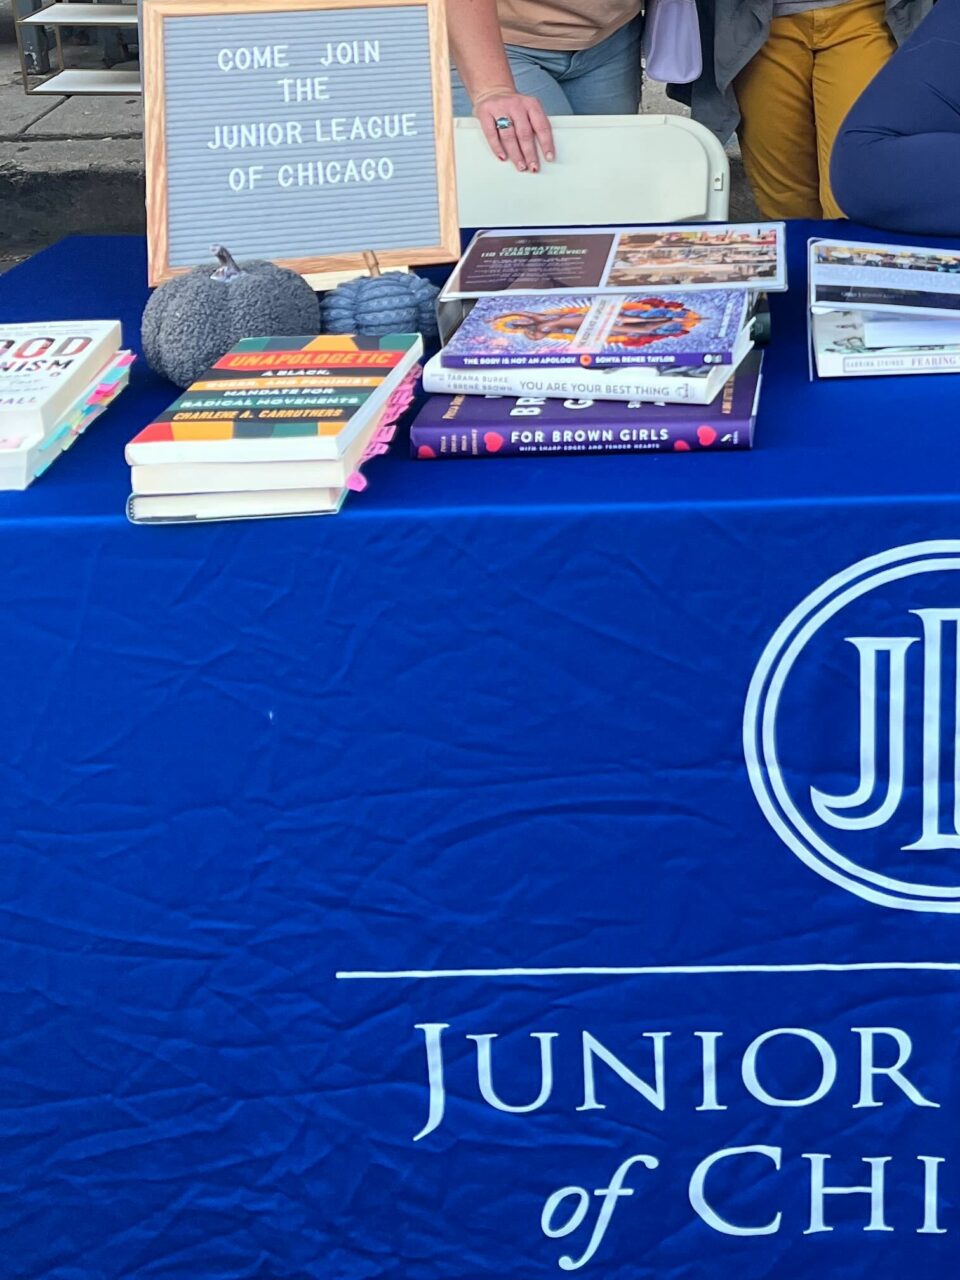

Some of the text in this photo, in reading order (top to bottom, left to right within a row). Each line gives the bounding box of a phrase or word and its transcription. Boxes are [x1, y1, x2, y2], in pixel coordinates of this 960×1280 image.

[217, 40, 381, 72] COME JOIN
[277, 77, 330, 102] THE
[207, 113, 418, 150] JUNIOR LEAGUE
[228, 157, 394, 191] OF CHICAGO
[228, 353, 393, 367] UNAPOLOGETIC
[464, 357, 479, 365] THE
[480, 357, 501, 365] BODY
[540, 356, 576, 364] APOLOGY
[595, 356, 620, 364] SONYA
[647, 355, 675, 363] TAYLOR
[911, 356, 956, 367] FEARING
[223, 387, 336, 397] MANDATE FOR
[519, 381, 670, 396] YOU ARE YOUR BEST THING
[180, 396, 360, 409] RADICAL MOVEMENTS
[173, 410, 239, 421] CHARLENE
[258, 408, 344, 419] CARRUTHERS
[511, 428, 669, 443] FOR BROWN GIRLS
[412, 1022, 941, 1143] JUNIOR
[540, 1154, 660, 1271] of
